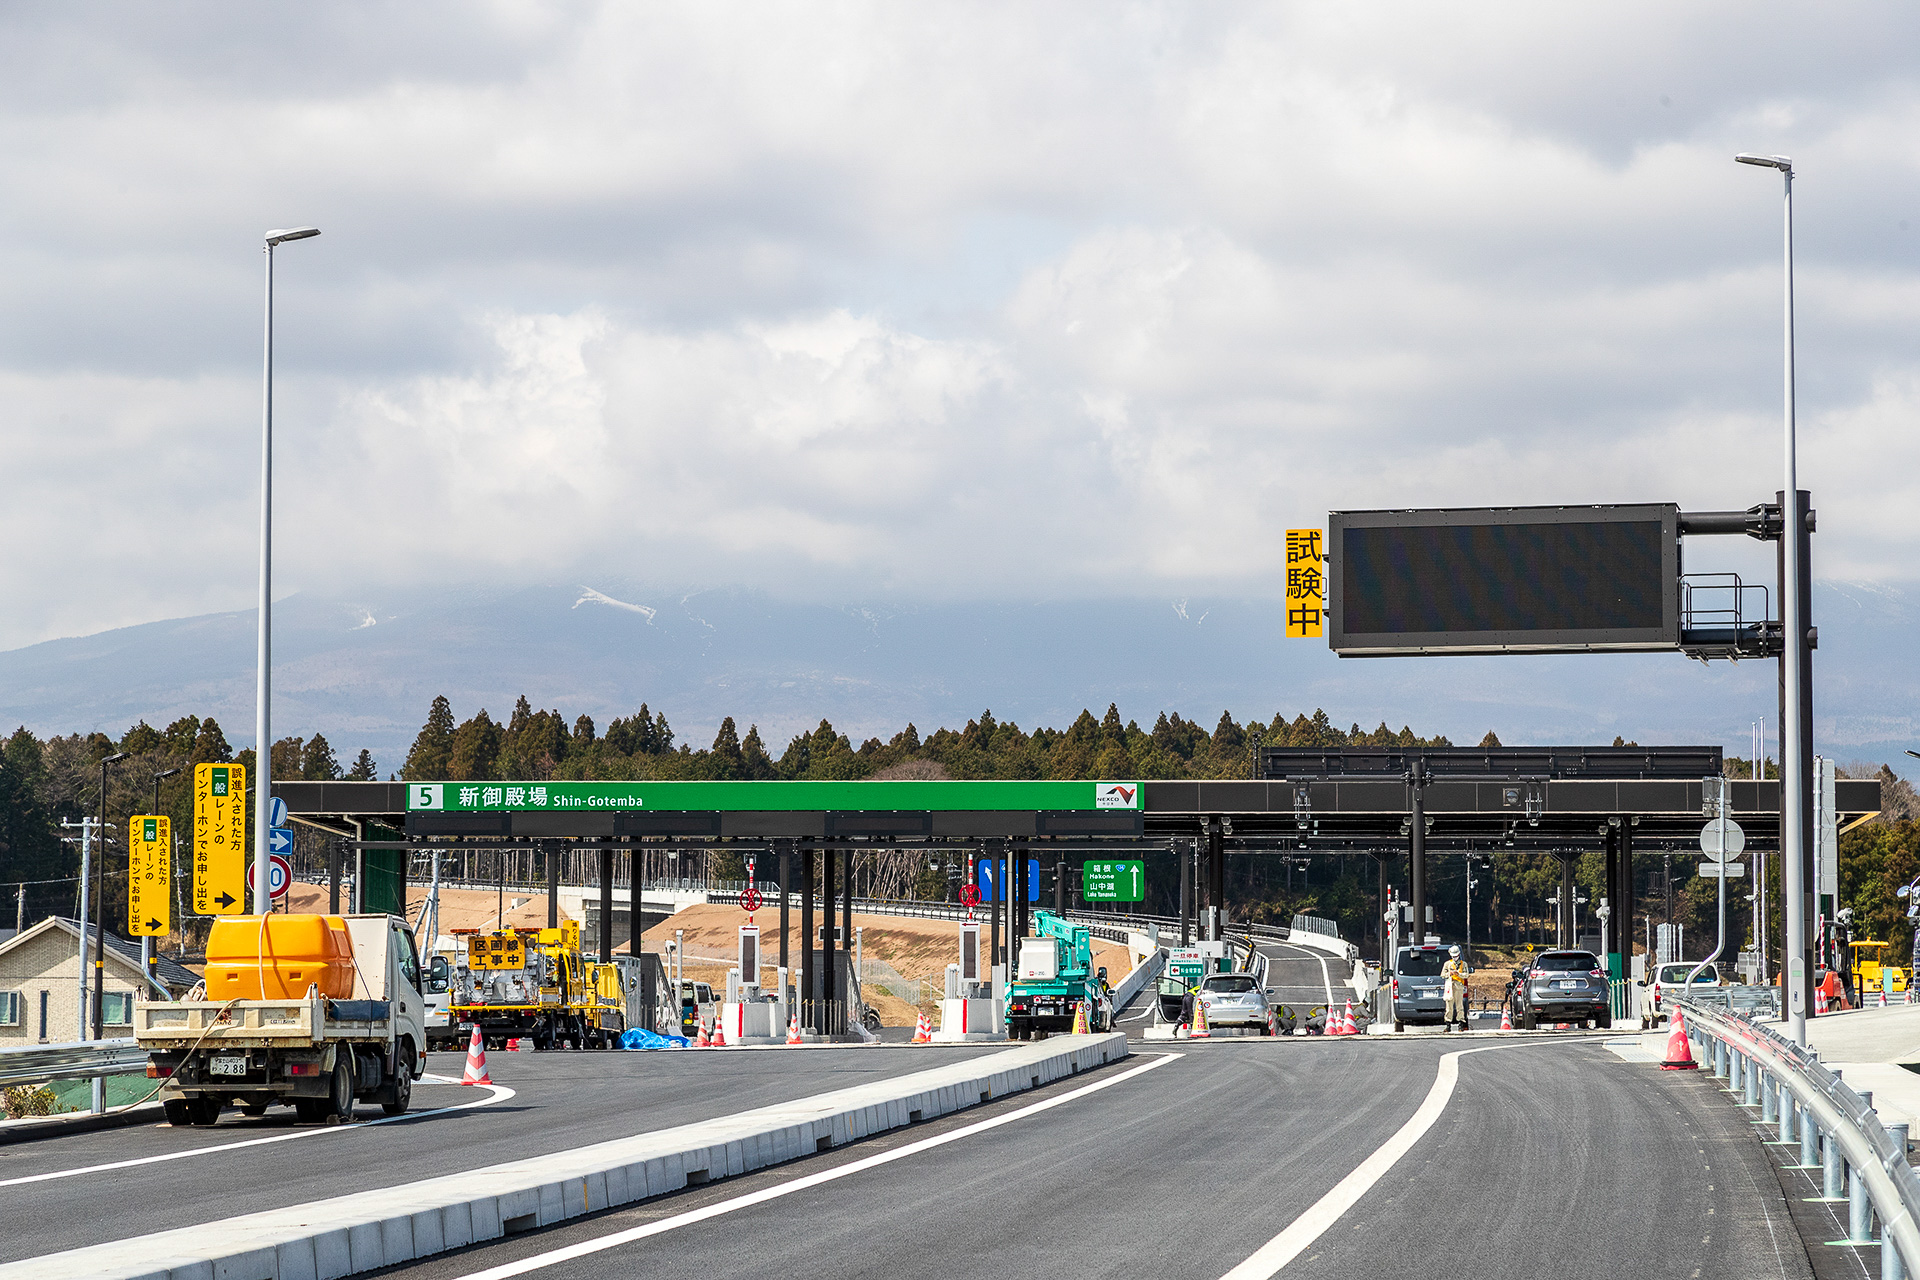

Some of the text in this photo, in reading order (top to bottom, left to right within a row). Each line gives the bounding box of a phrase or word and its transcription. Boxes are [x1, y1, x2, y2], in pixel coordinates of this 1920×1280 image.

[1286, 531, 1322, 635] 試験中
[231, 767, 243, 851] 誤進入された方
[420, 787, 433, 807] 5
[459, 786, 548, 807] 新御殿場
[553, 795, 643, 807] Shin-Gotemba
[158, 819, 168, 886] 誤進入された方
[196, 767, 209, 911] インターホンでお申し出を
[131, 819, 141, 933] インターホンでお申し出を
[1090, 882, 1115, 891] 山中湖
[474, 954, 520, 966] 工事中
